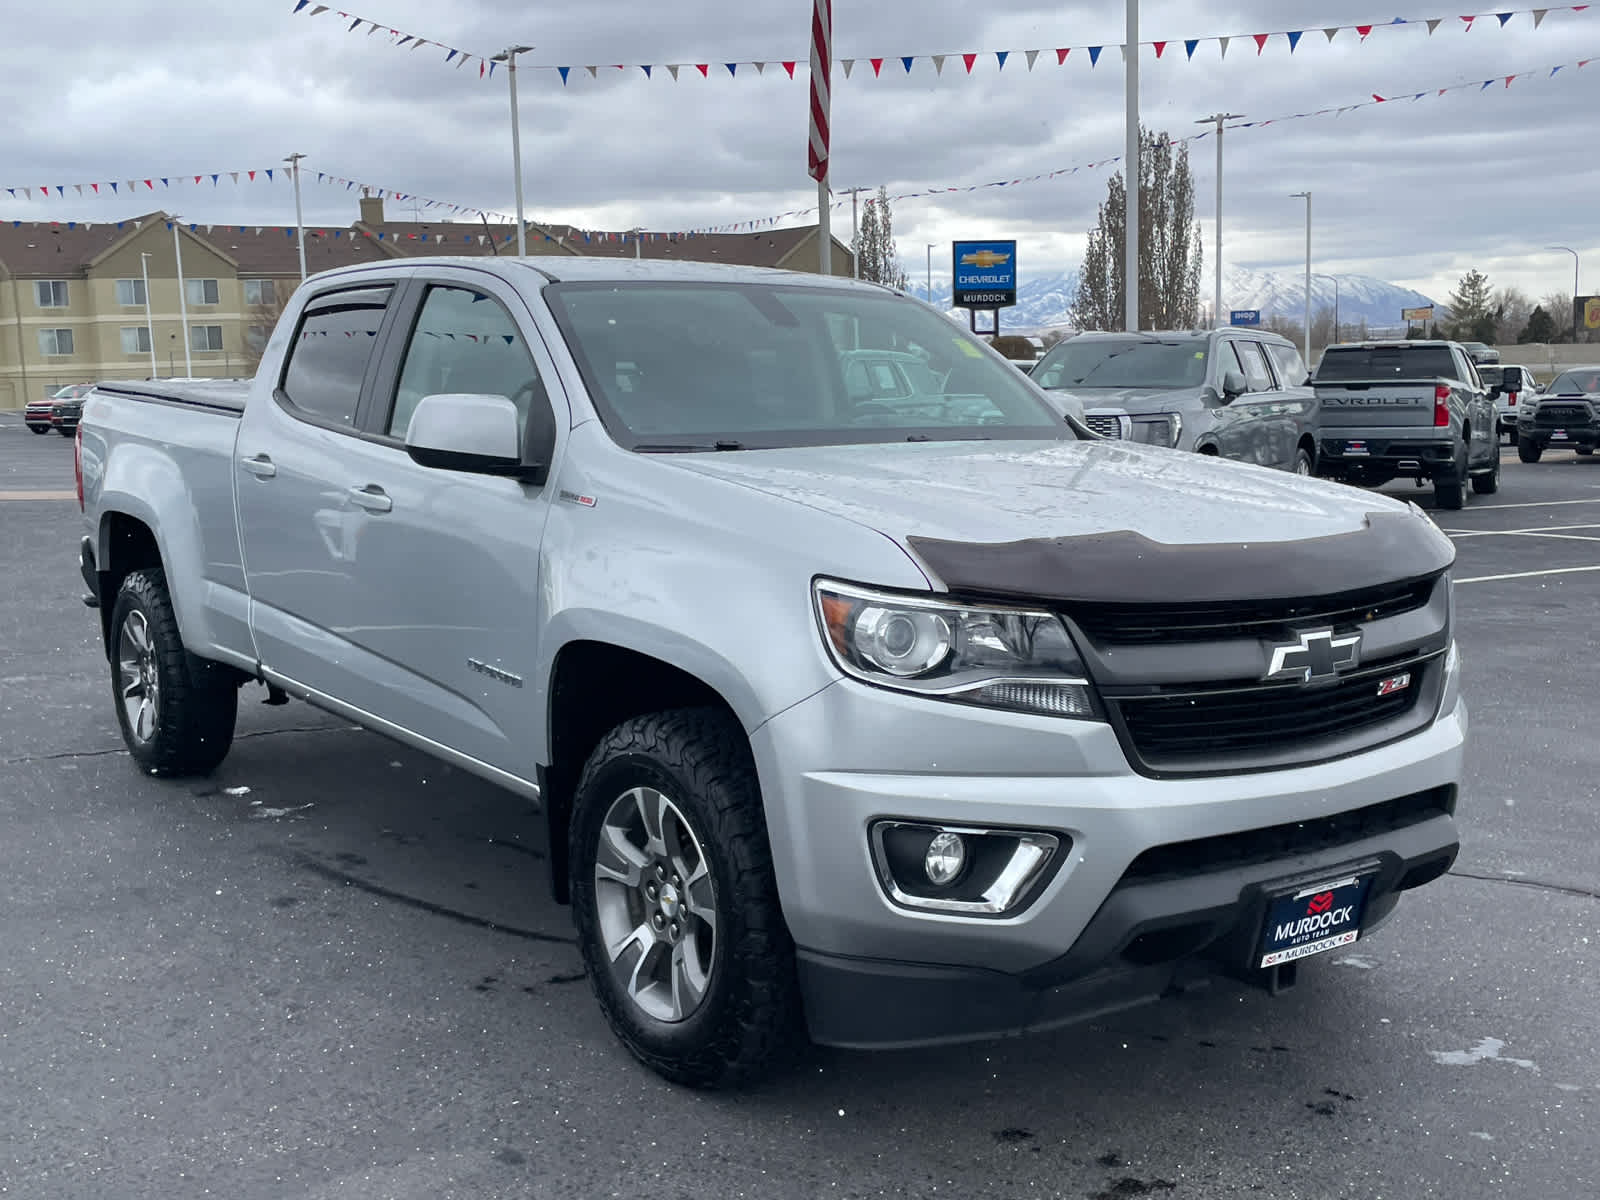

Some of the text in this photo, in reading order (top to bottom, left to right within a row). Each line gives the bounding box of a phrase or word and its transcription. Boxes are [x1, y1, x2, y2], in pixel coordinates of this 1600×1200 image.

[959, 275, 1010, 283] CHEVROLET
[963, 294, 1007, 302] MURDOCK
[1321, 397, 1424, 406] EVROLET
[1274, 905, 1353, 941] MURDOCK
[1291, 929, 1330, 944] AUTO TEAM
[1285, 941, 1336, 959] MURDOCK
